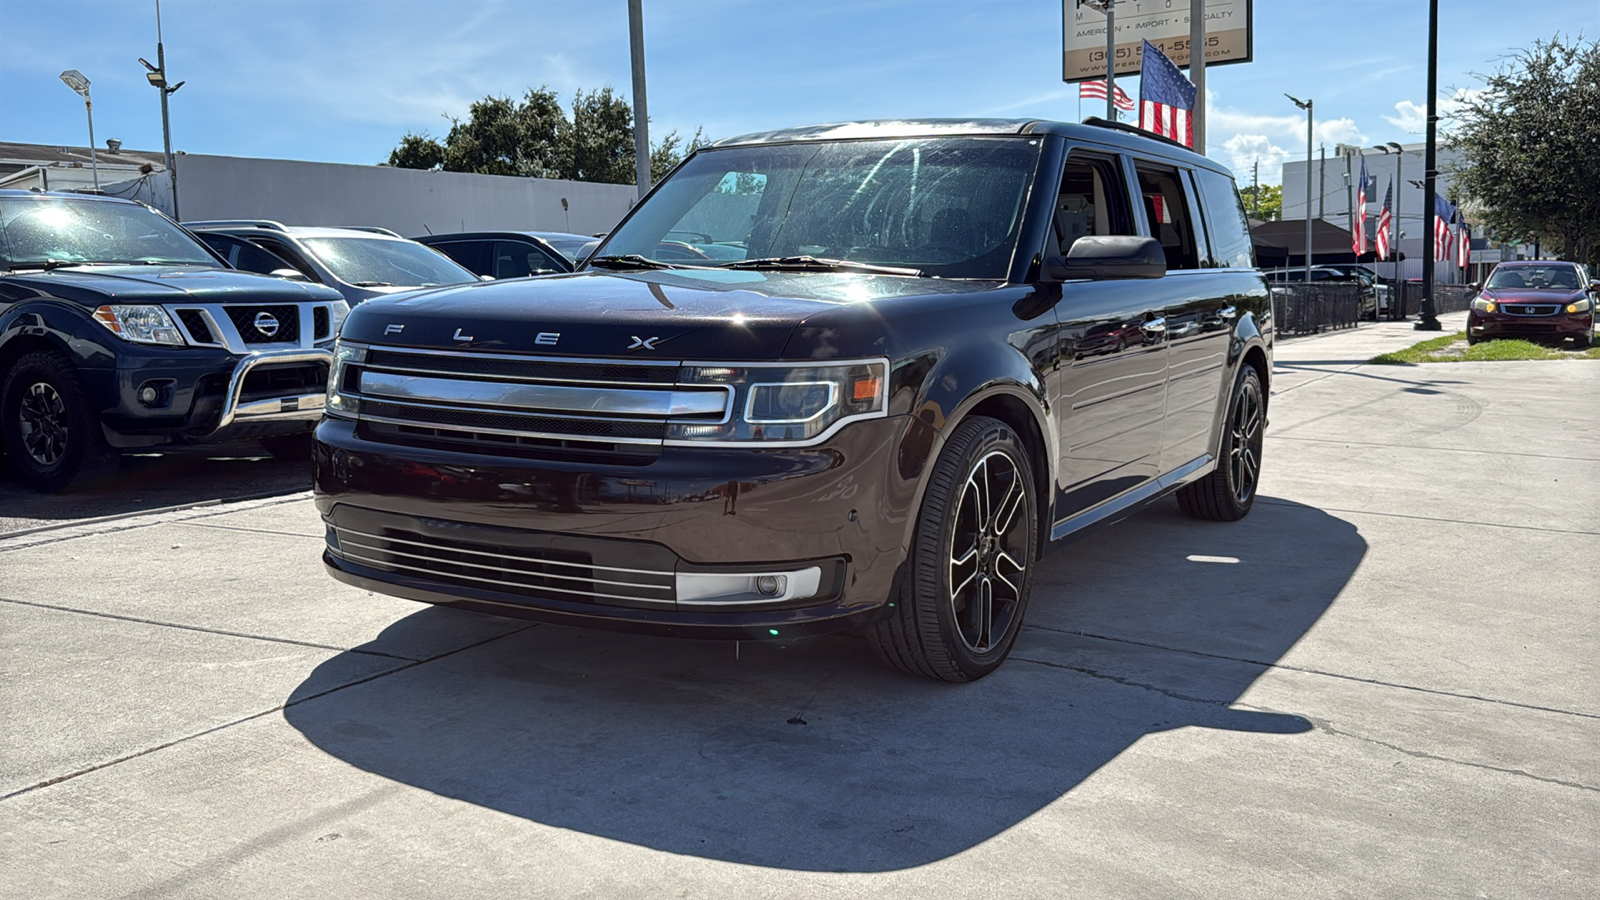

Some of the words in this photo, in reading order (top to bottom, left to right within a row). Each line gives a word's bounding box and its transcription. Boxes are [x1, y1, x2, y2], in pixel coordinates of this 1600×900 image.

[1076, 26, 1122, 38] AMERICN
[1135, 19, 1170, 29] IMPORT
[1183, 10, 1233, 24] SCIALTY
[384, 324, 659, 350] FLEX
